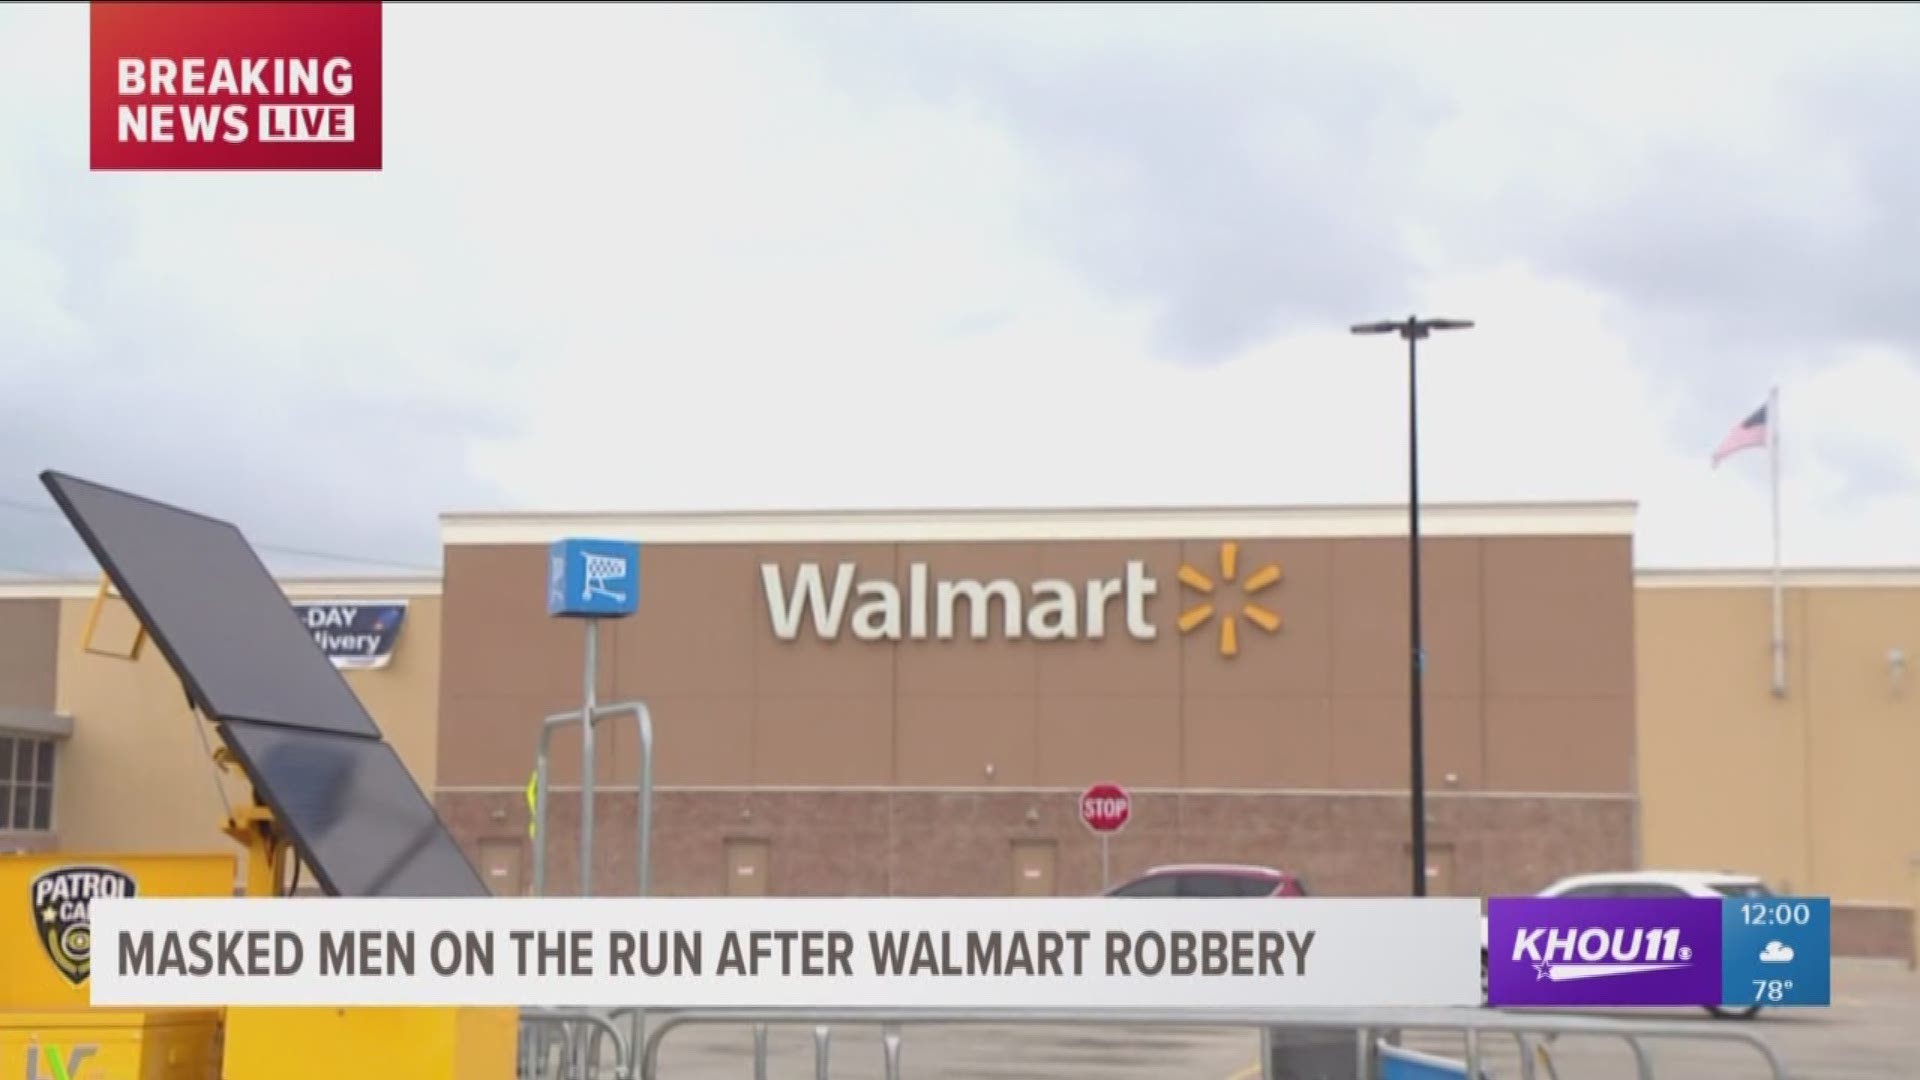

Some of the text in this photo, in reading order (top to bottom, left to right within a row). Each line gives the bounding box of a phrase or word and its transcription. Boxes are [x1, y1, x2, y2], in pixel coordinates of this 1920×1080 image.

[761, 560, 1157, 639] Walmart
[1085, 797, 1127, 818] STOP
[60, 900, 91, 921] CA
